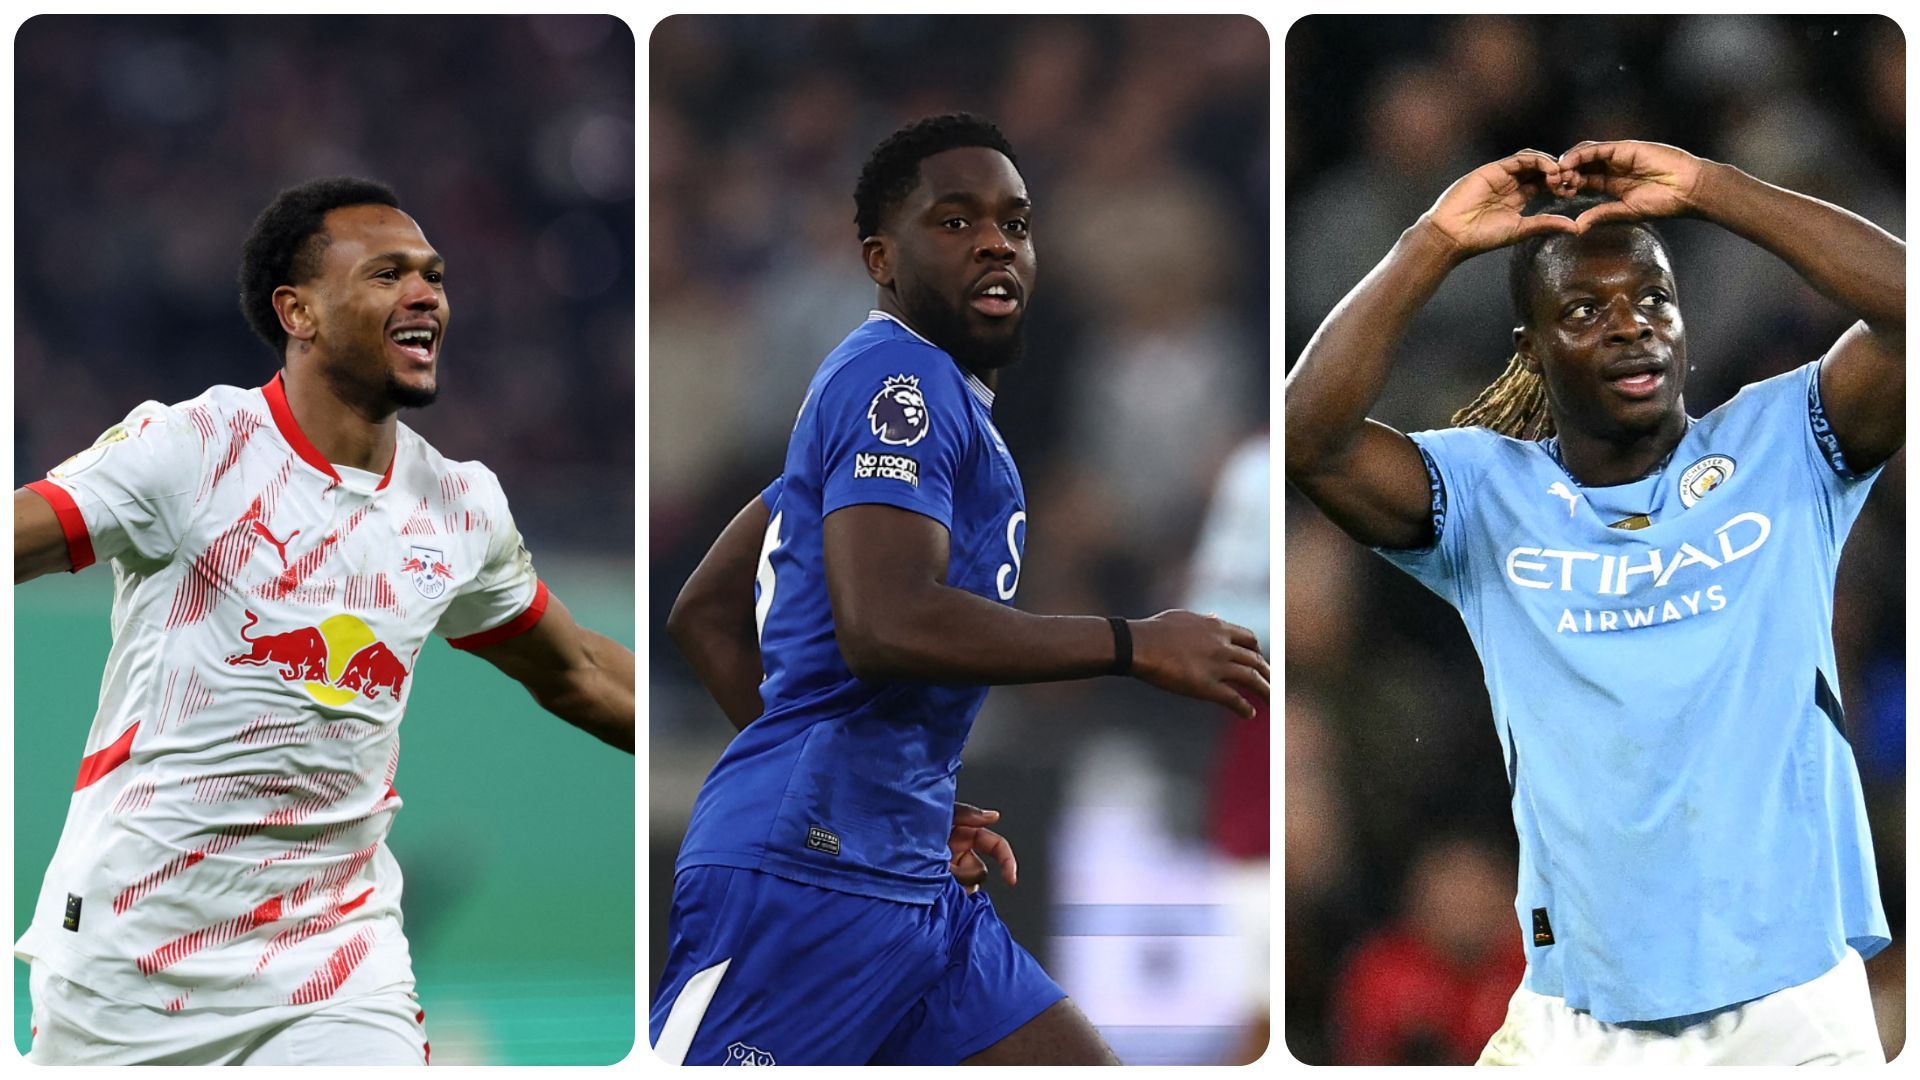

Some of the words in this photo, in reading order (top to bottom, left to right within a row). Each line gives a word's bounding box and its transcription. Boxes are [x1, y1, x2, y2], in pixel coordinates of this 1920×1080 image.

[856, 453, 877, 467] No
[880, 455, 916, 473] room
[877, 467, 918, 488] racism
[1682, 459, 1723, 495] MANCHESTER
[1506, 511, 1771, 594] ETIHAD
[1557, 585, 1727, 633] AIRWAYS
